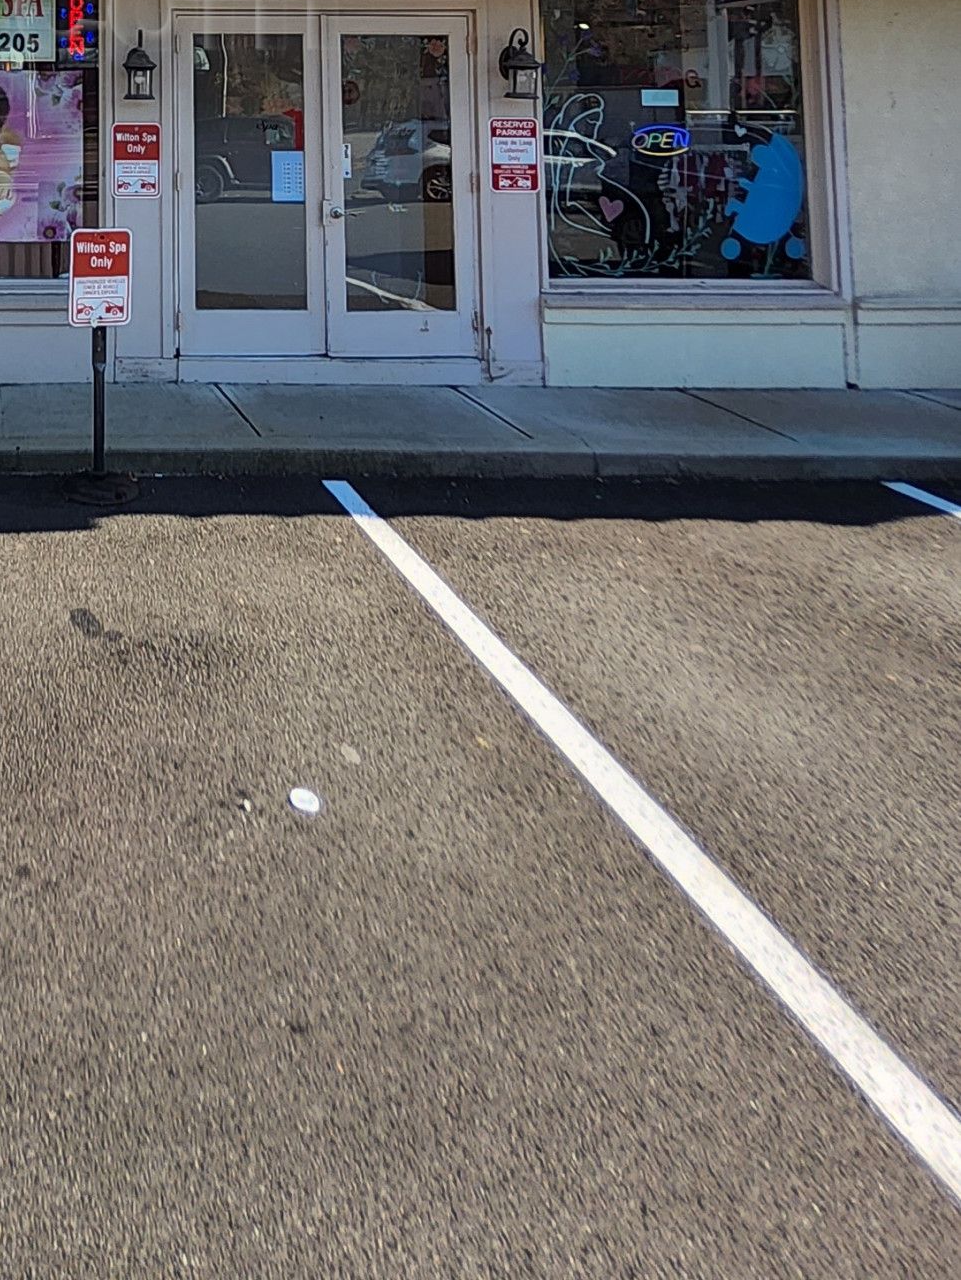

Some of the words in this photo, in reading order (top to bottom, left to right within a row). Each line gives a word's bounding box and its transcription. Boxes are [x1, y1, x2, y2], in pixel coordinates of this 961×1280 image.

[492, 121, 535, 129] RESERVED
[116, 132, 139, 142] Wilton
[142, 132, 157, 143] Spa
[631, 131, 690, 150] OPEN
[127, 144, 145, 155] Only
[76, 242, 106, 253] Wilton
[109, 241, 127, 255] Spa
[90, 256, 113, 270] Only
